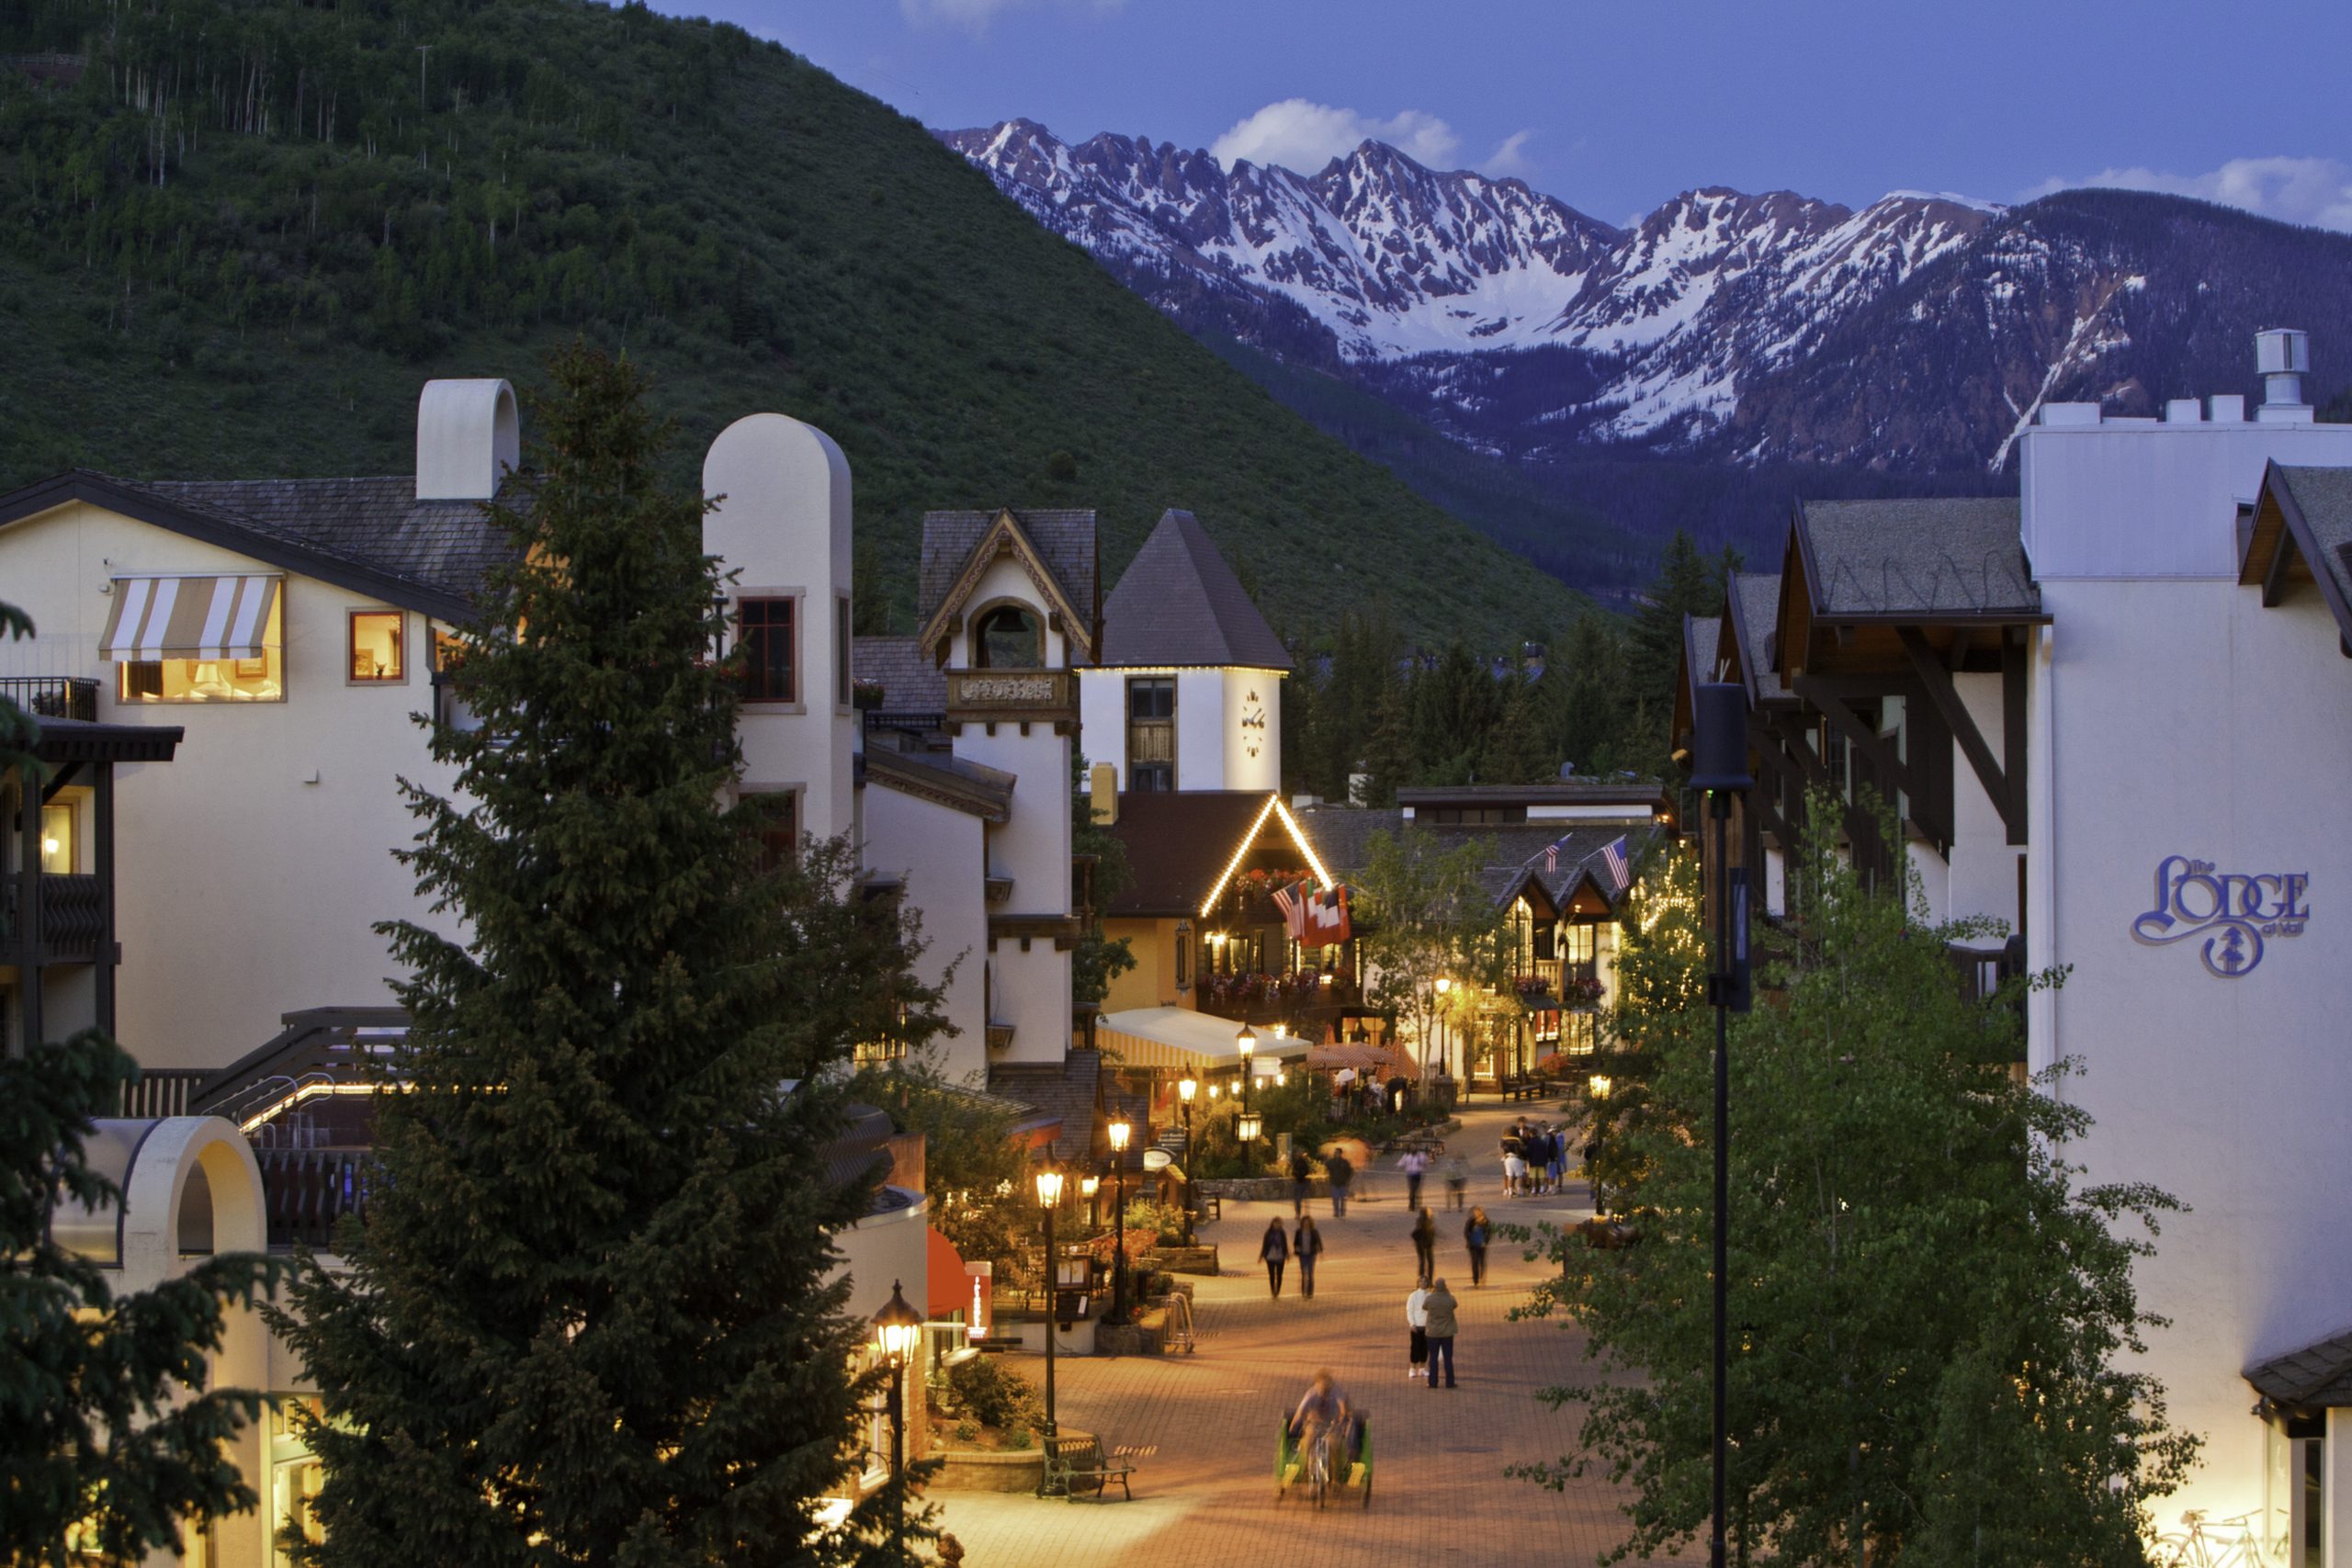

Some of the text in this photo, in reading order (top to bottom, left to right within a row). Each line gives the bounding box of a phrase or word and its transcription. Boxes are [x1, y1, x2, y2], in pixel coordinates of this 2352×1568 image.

[2190, 859, 2216, 873] The
[2130, 855, 2310, 948] LODGE
[2261, 920, 2305, 936] at Vail
